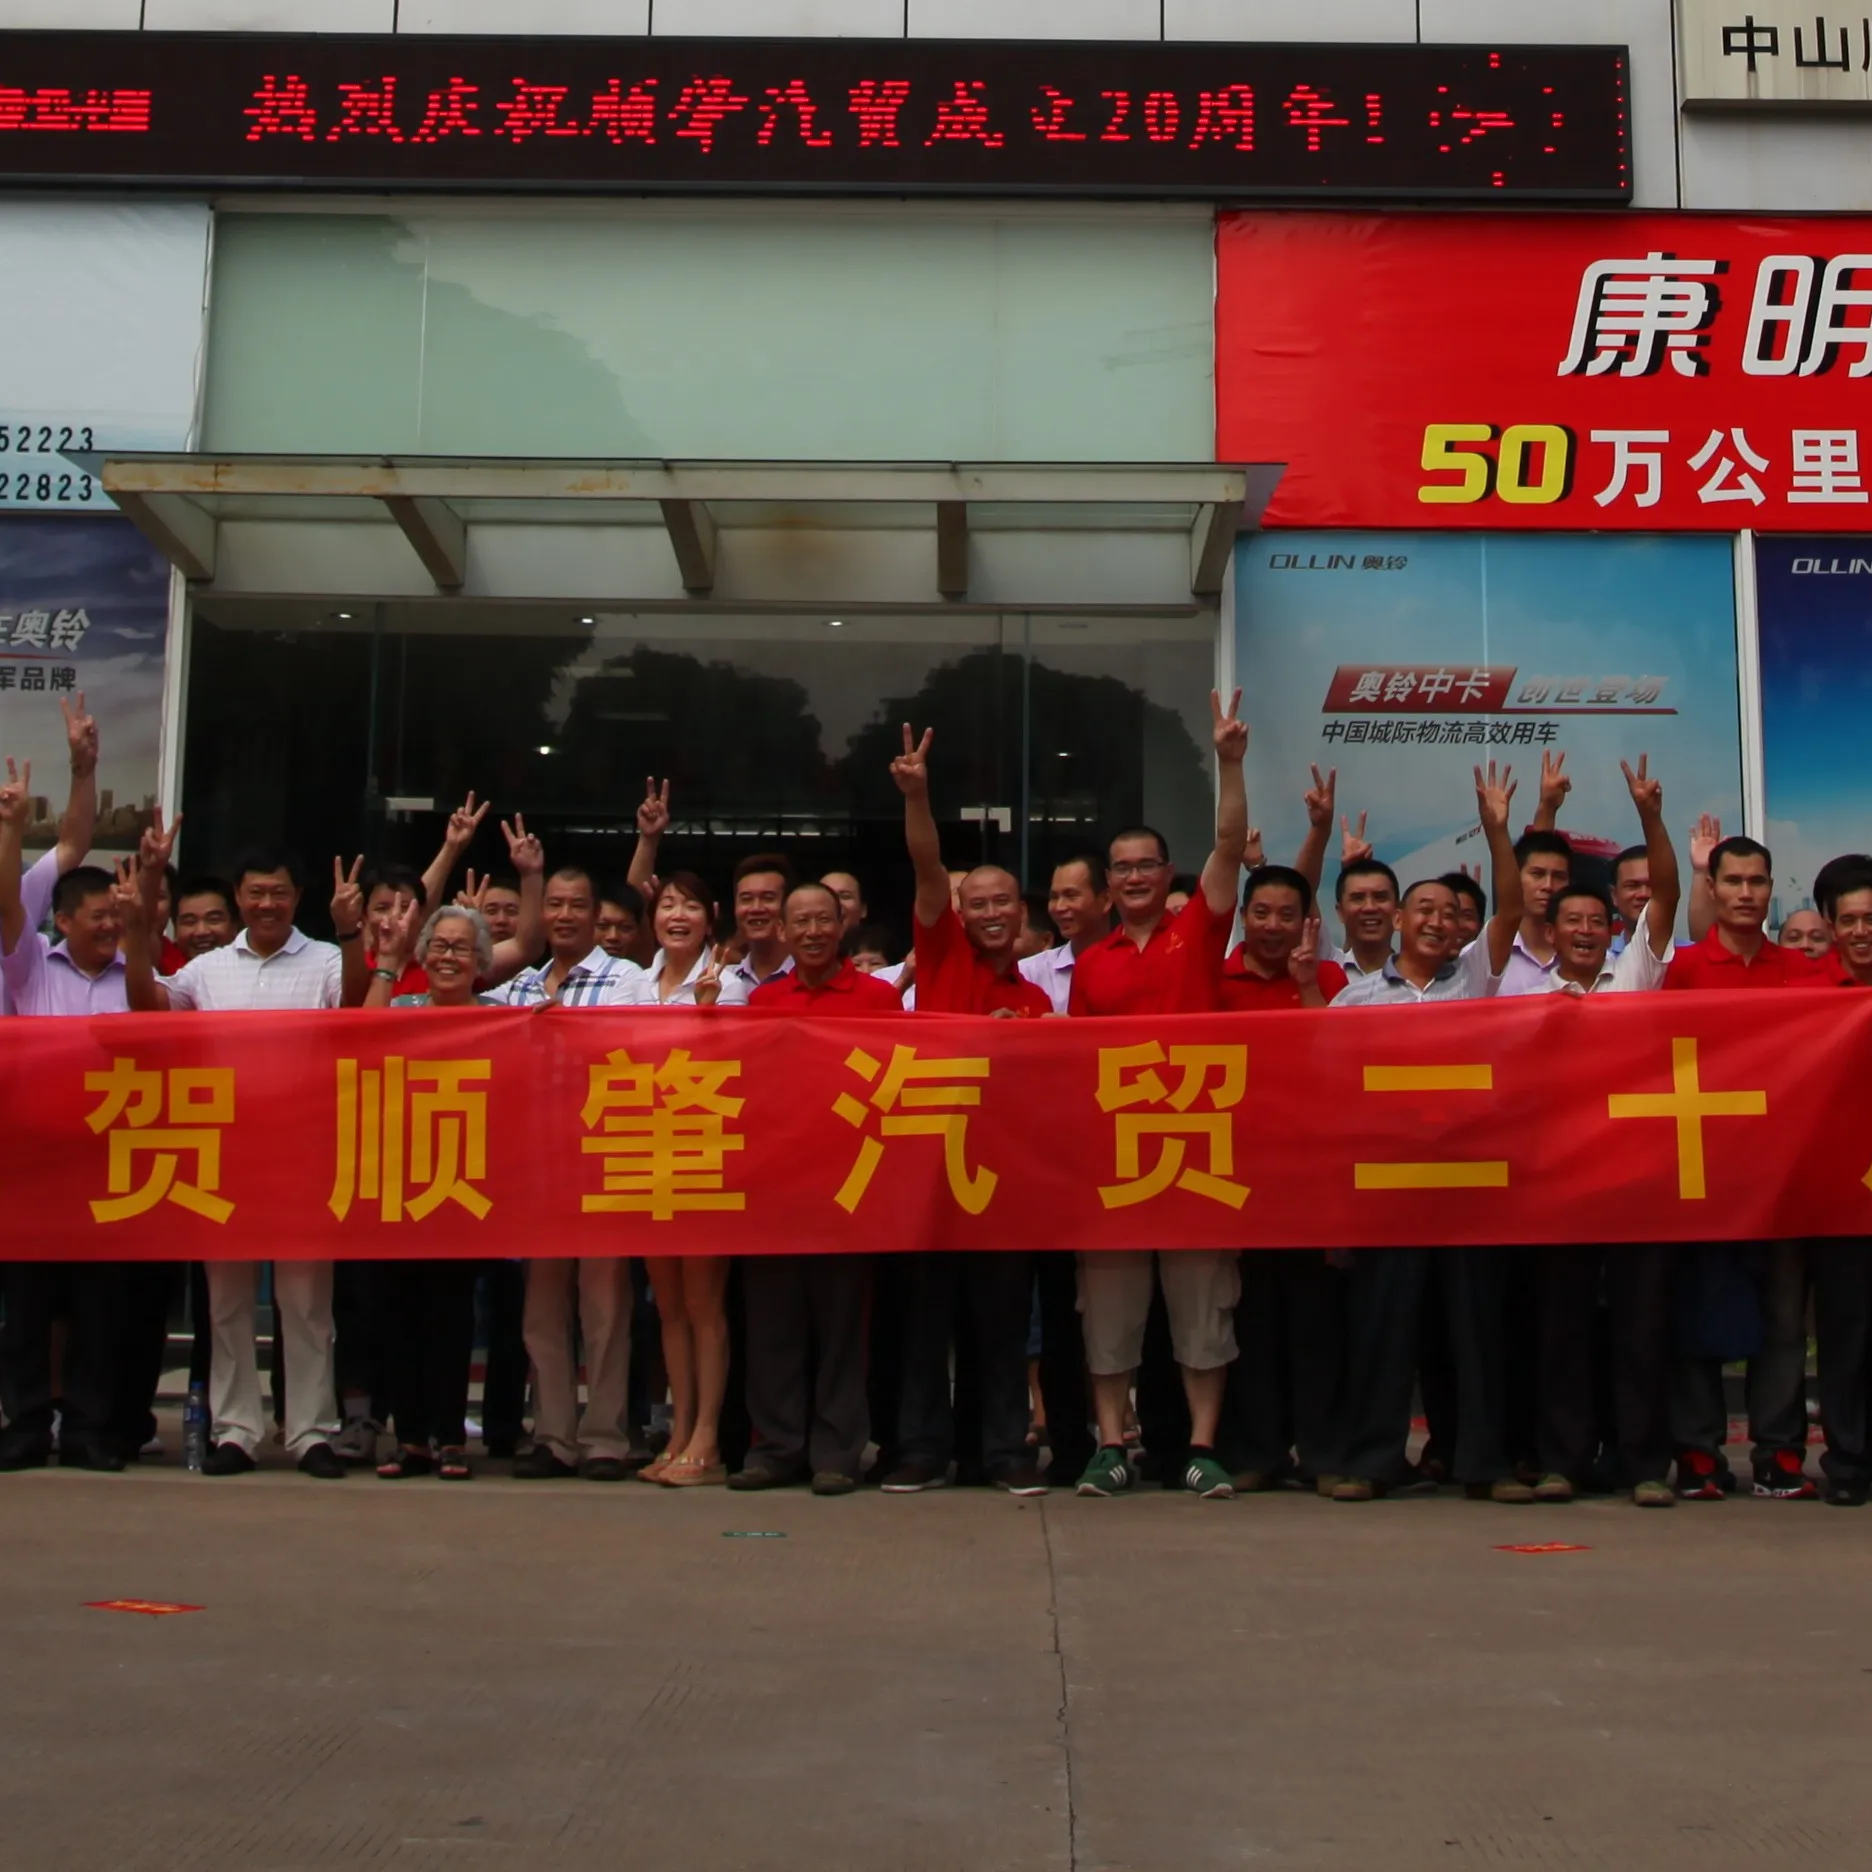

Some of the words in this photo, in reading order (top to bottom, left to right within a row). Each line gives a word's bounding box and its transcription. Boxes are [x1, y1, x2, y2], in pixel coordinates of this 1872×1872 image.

[1268, 554, 1357, 570] OLLIN
[1348, 666, 1492, 705] 奥铃中卡
[1320, 719, 1561, 747] 中国城际物流高效用车
